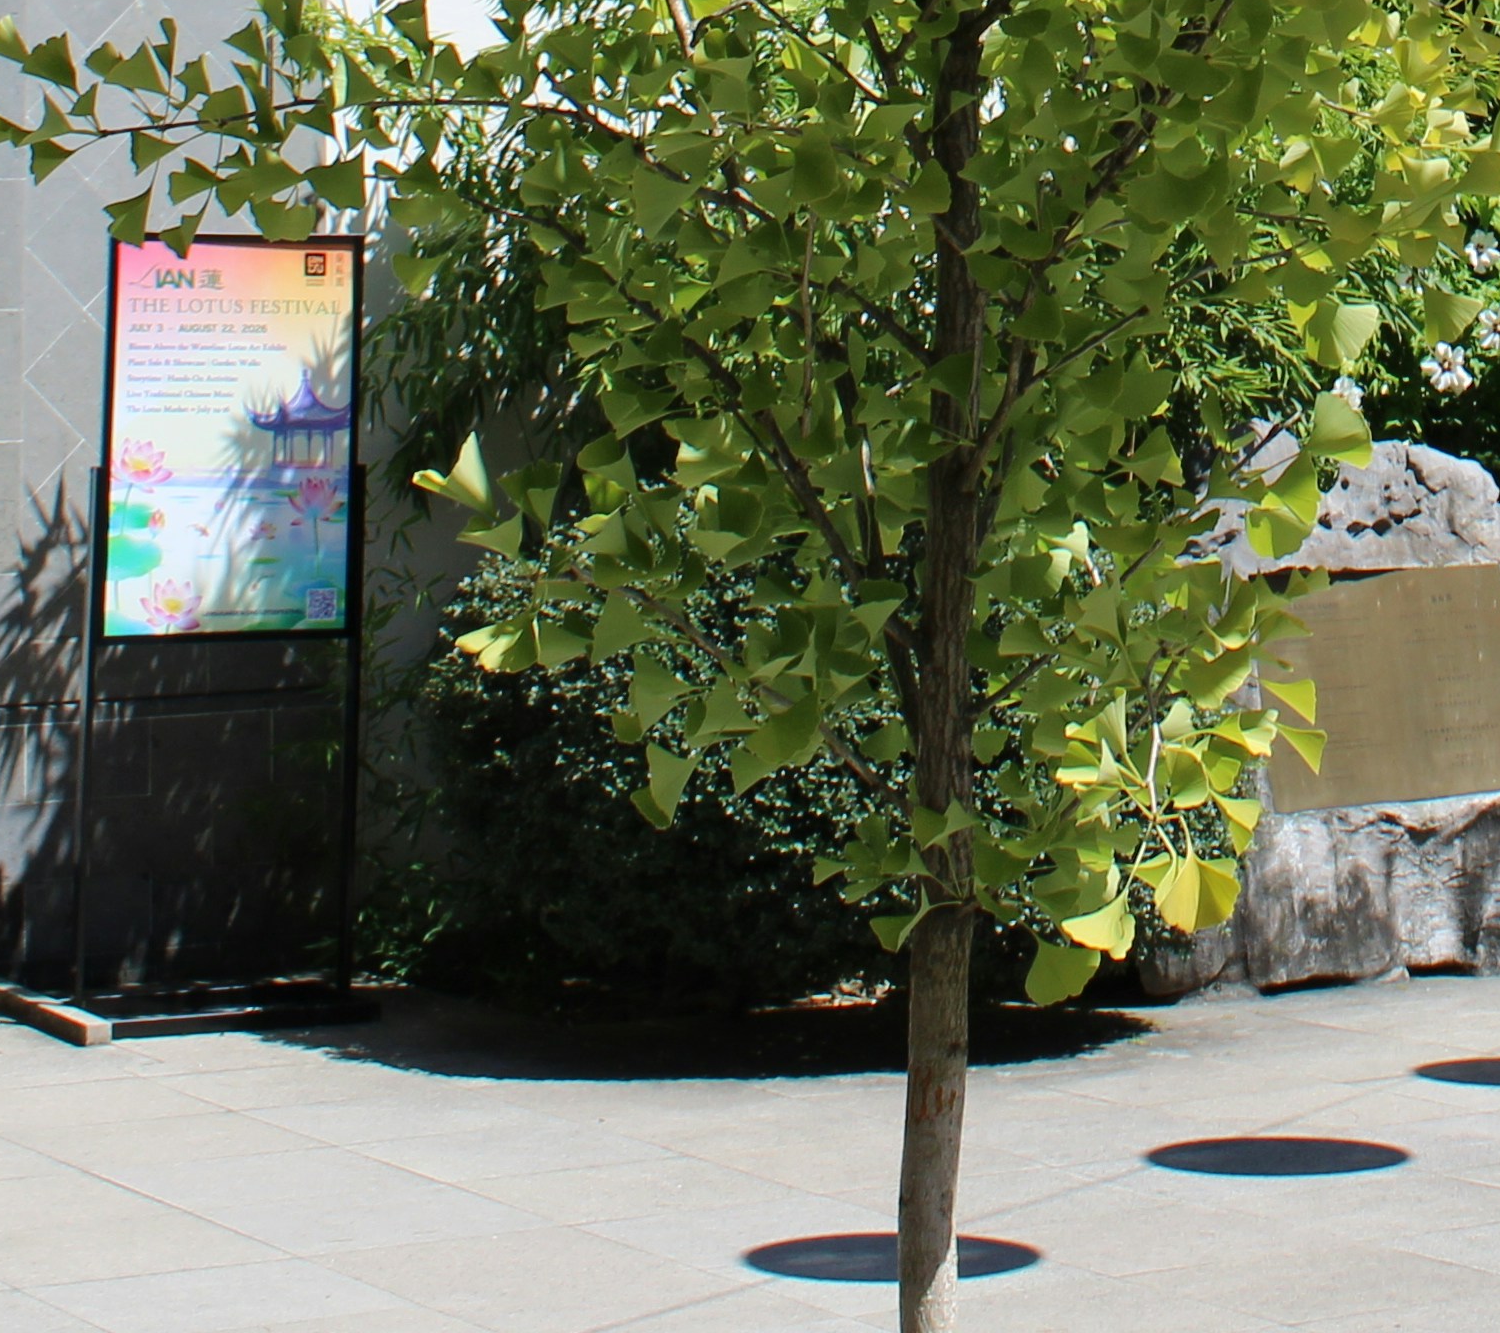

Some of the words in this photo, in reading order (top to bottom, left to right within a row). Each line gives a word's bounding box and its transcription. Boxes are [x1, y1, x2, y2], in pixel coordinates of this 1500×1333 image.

[198, 268, 226, 290] 蓮
[128, 297, 171, 313] THE
[176, 298, 244, 314] LOTUS
[250, 299, 342, 315] FESTIVAL
[129, 323, 152, 333] JULY
[156, 324, 164, 333] 3
[178, 323, 218, 333] AUGUST
[240, 324, 268, 334] 2026
